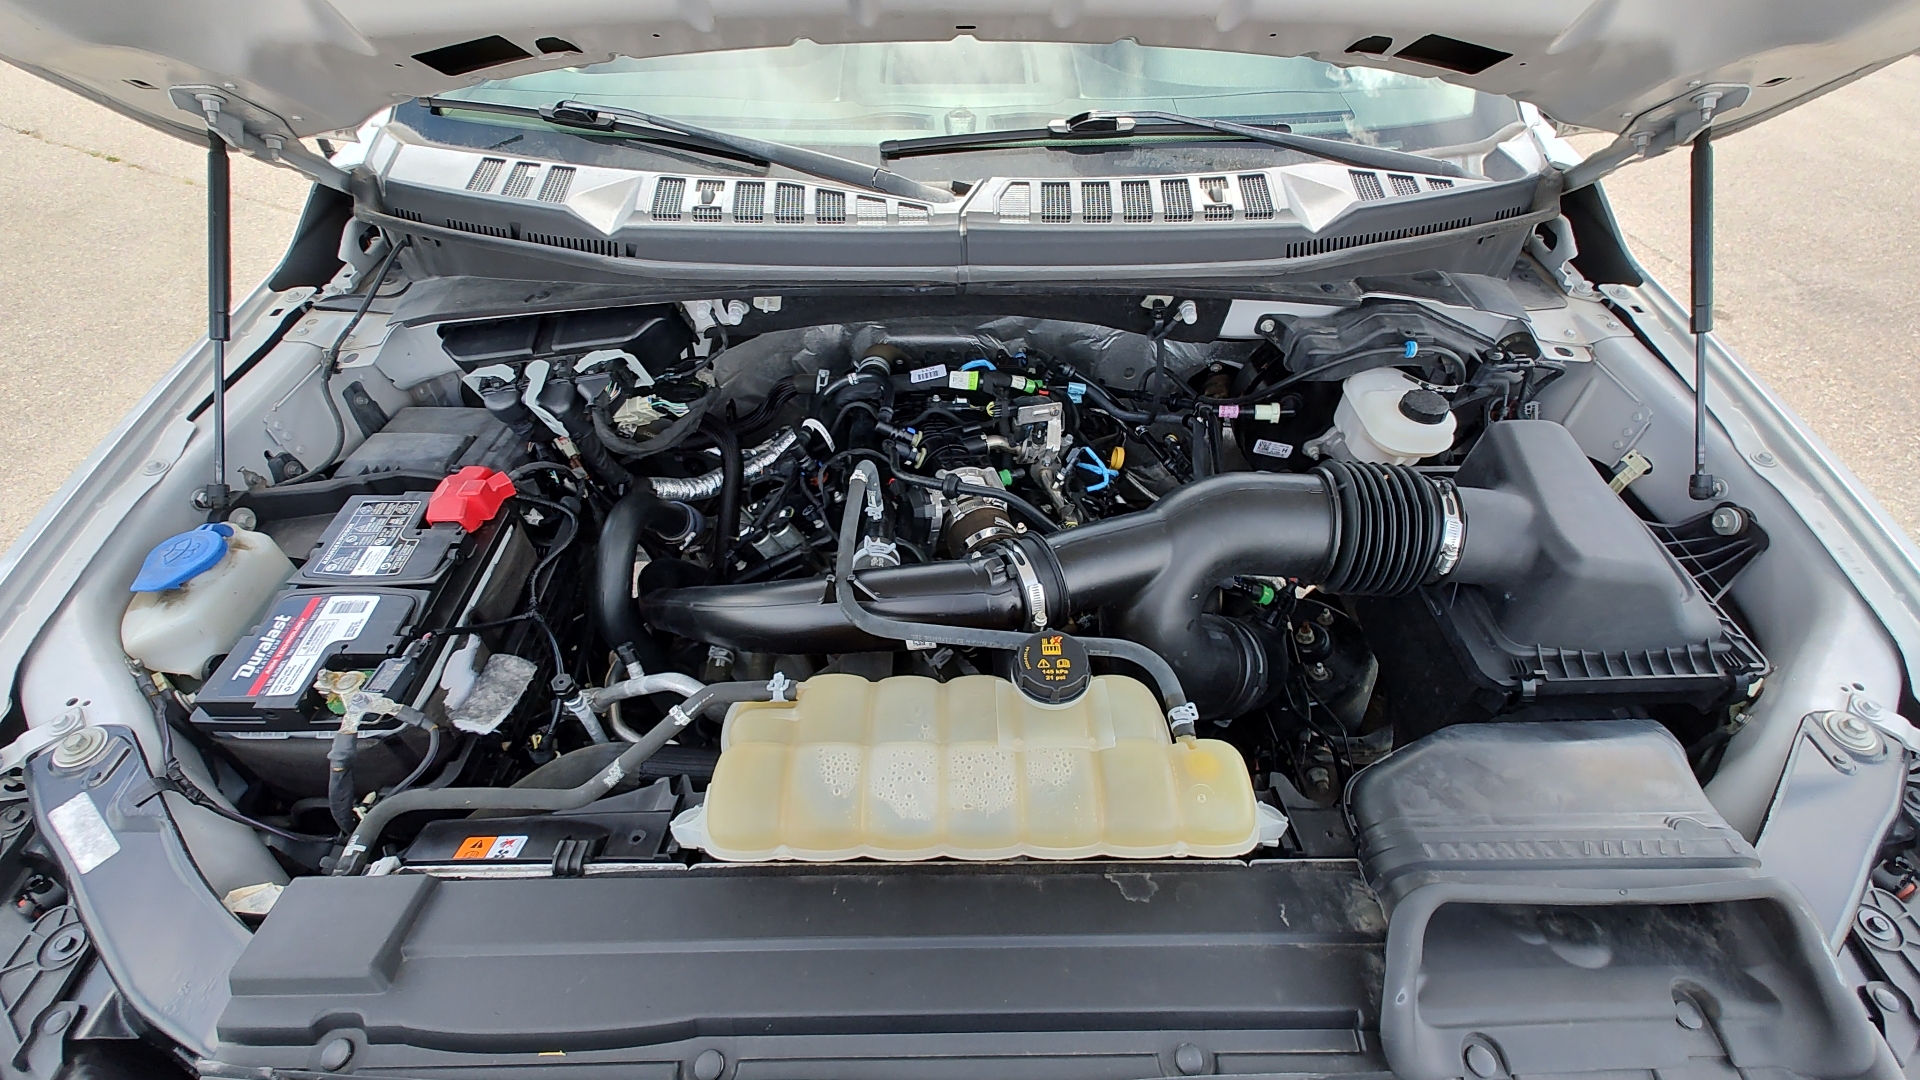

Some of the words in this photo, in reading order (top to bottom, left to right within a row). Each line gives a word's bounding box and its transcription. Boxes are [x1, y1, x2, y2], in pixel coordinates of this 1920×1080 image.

[231, 614, 292, 681] Duralast
[254, 639, 282, 674] PLATINUM
[265, 659, 279, 675] AGM
[277, 617, 306, 658] TECHNOLOGY
